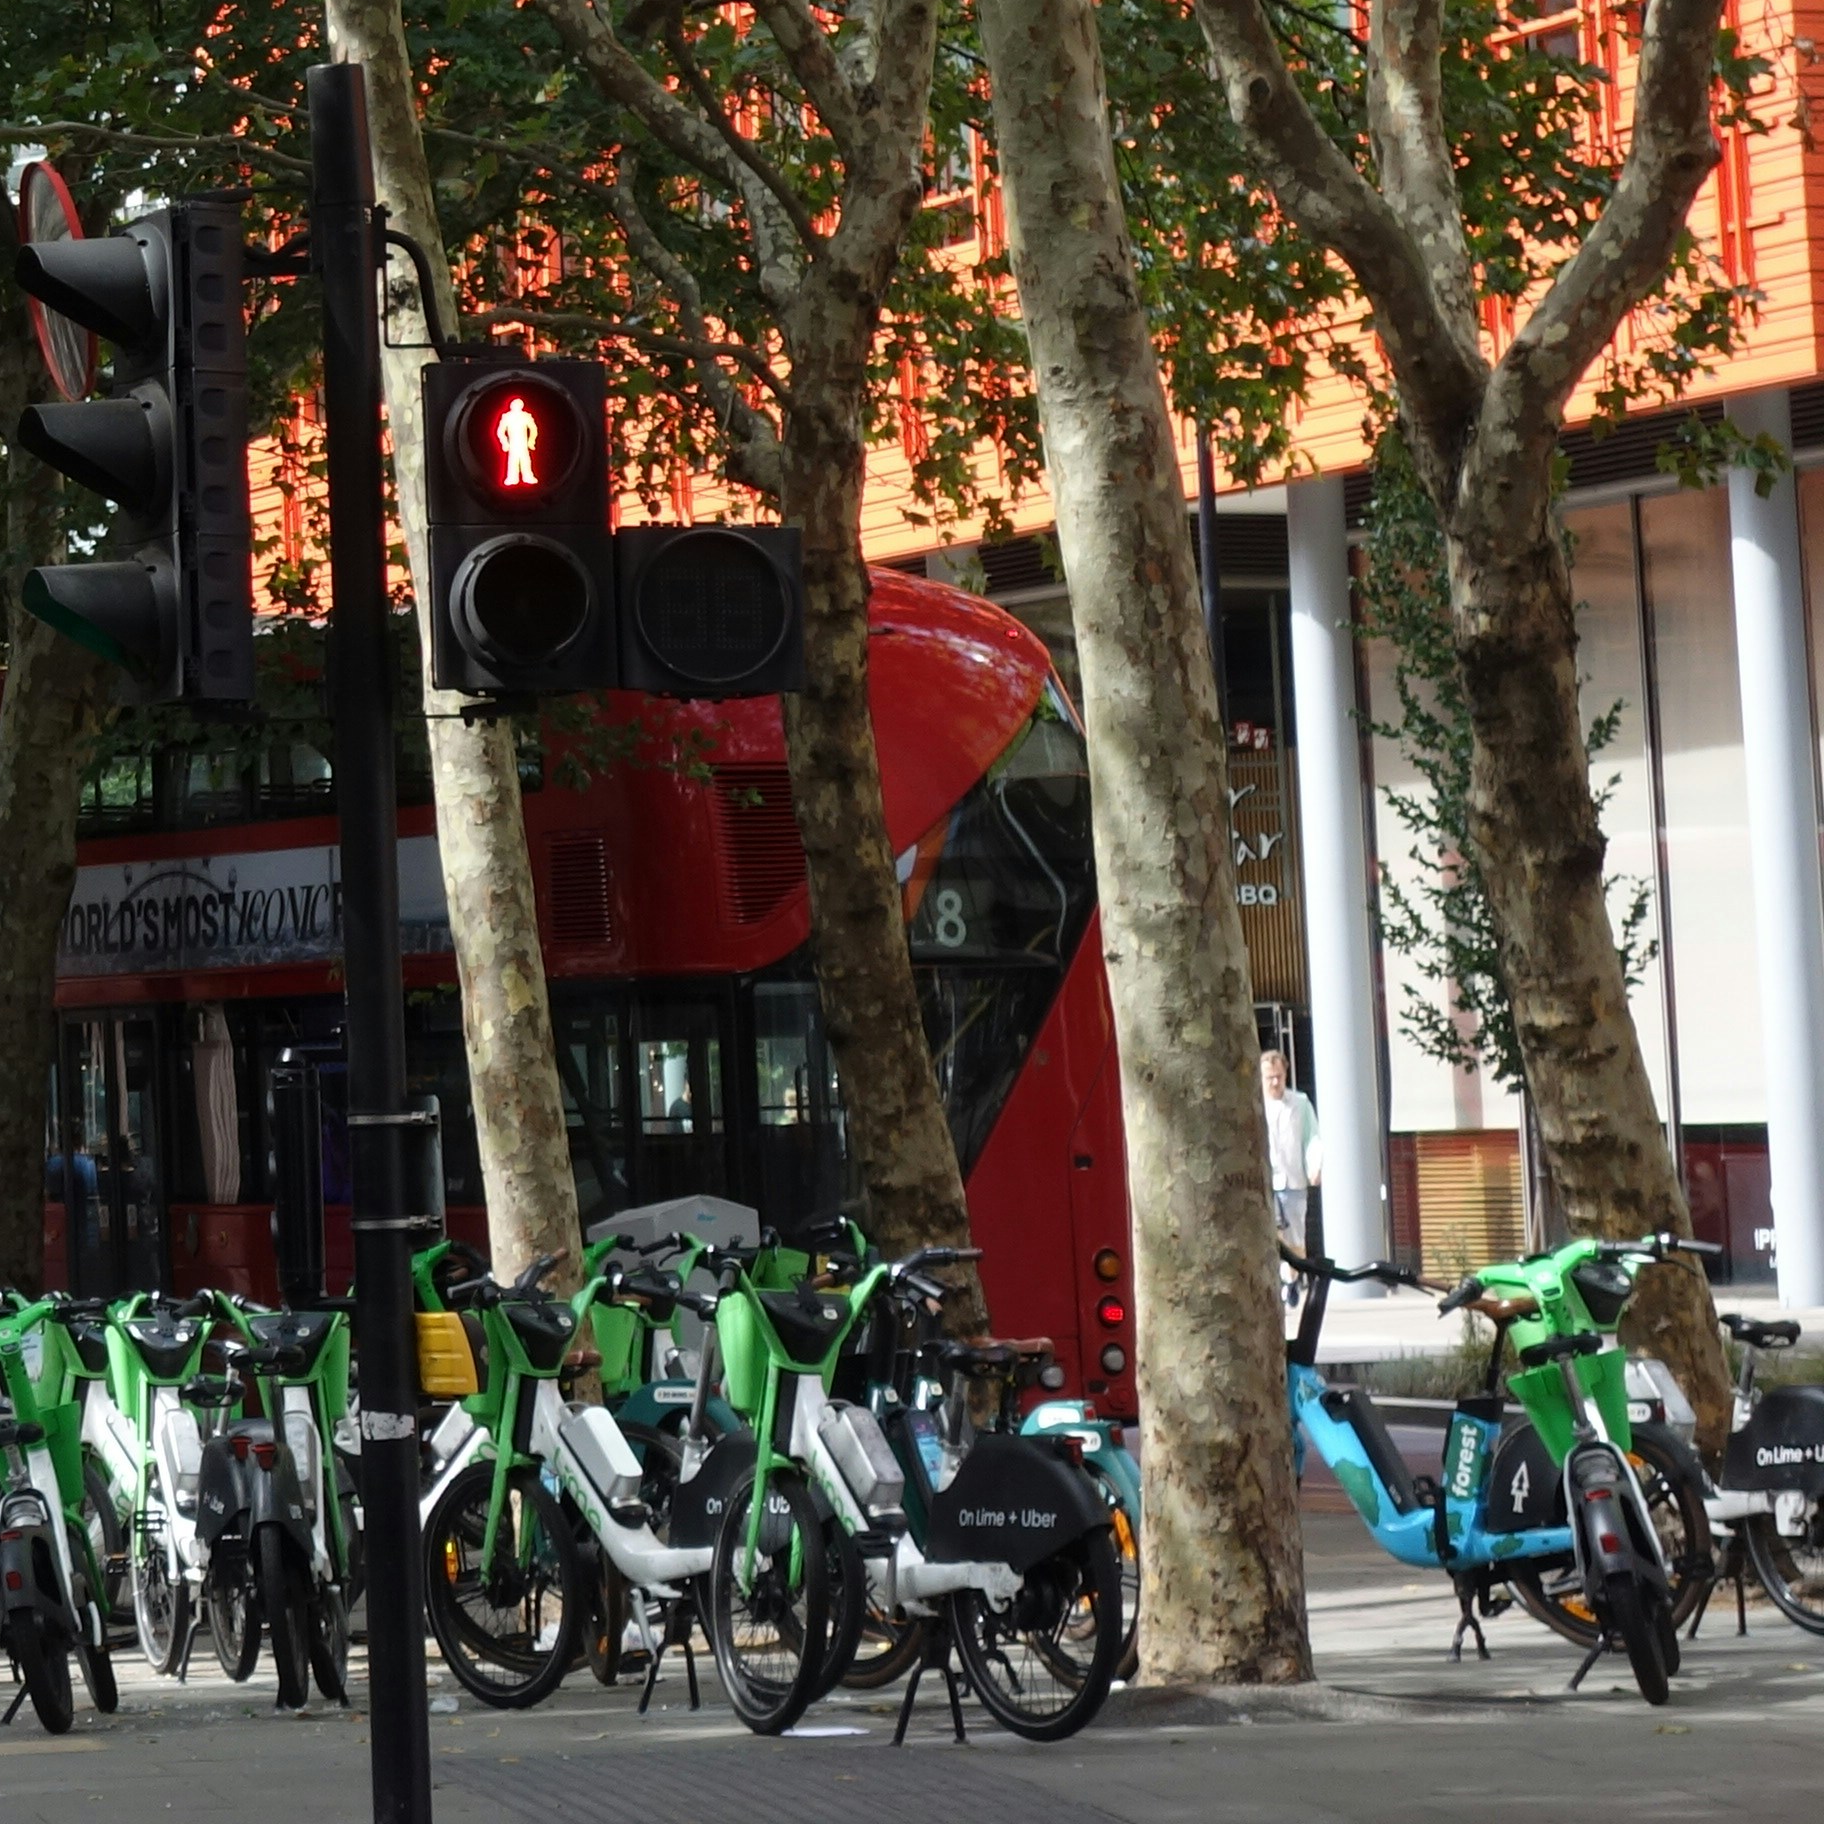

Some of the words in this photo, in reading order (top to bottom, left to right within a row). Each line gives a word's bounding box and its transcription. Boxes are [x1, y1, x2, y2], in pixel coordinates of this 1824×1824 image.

[1236, 884, 1279, 907] BQ
[61, 898, 160, 954] ORLD'S
[164, 891, 236, 951] MOST
[236, 882, 329, 947] ICONIC
[1452, 1424, 1478, 1497] forest
[1756, 1447, 1773, 1466] On
[1774, 1445, 1803, 1464] Lime
[554, 1447, 602, 1532] Lime
[706, 1498, 723, 1515] On
[769, 1495, 791, 1514] Ub
[958, 1508, 974, 1527] On
[975, 1507, 1005, 1527] Lime
[1020, 1507, 1057, 1528] Uber
